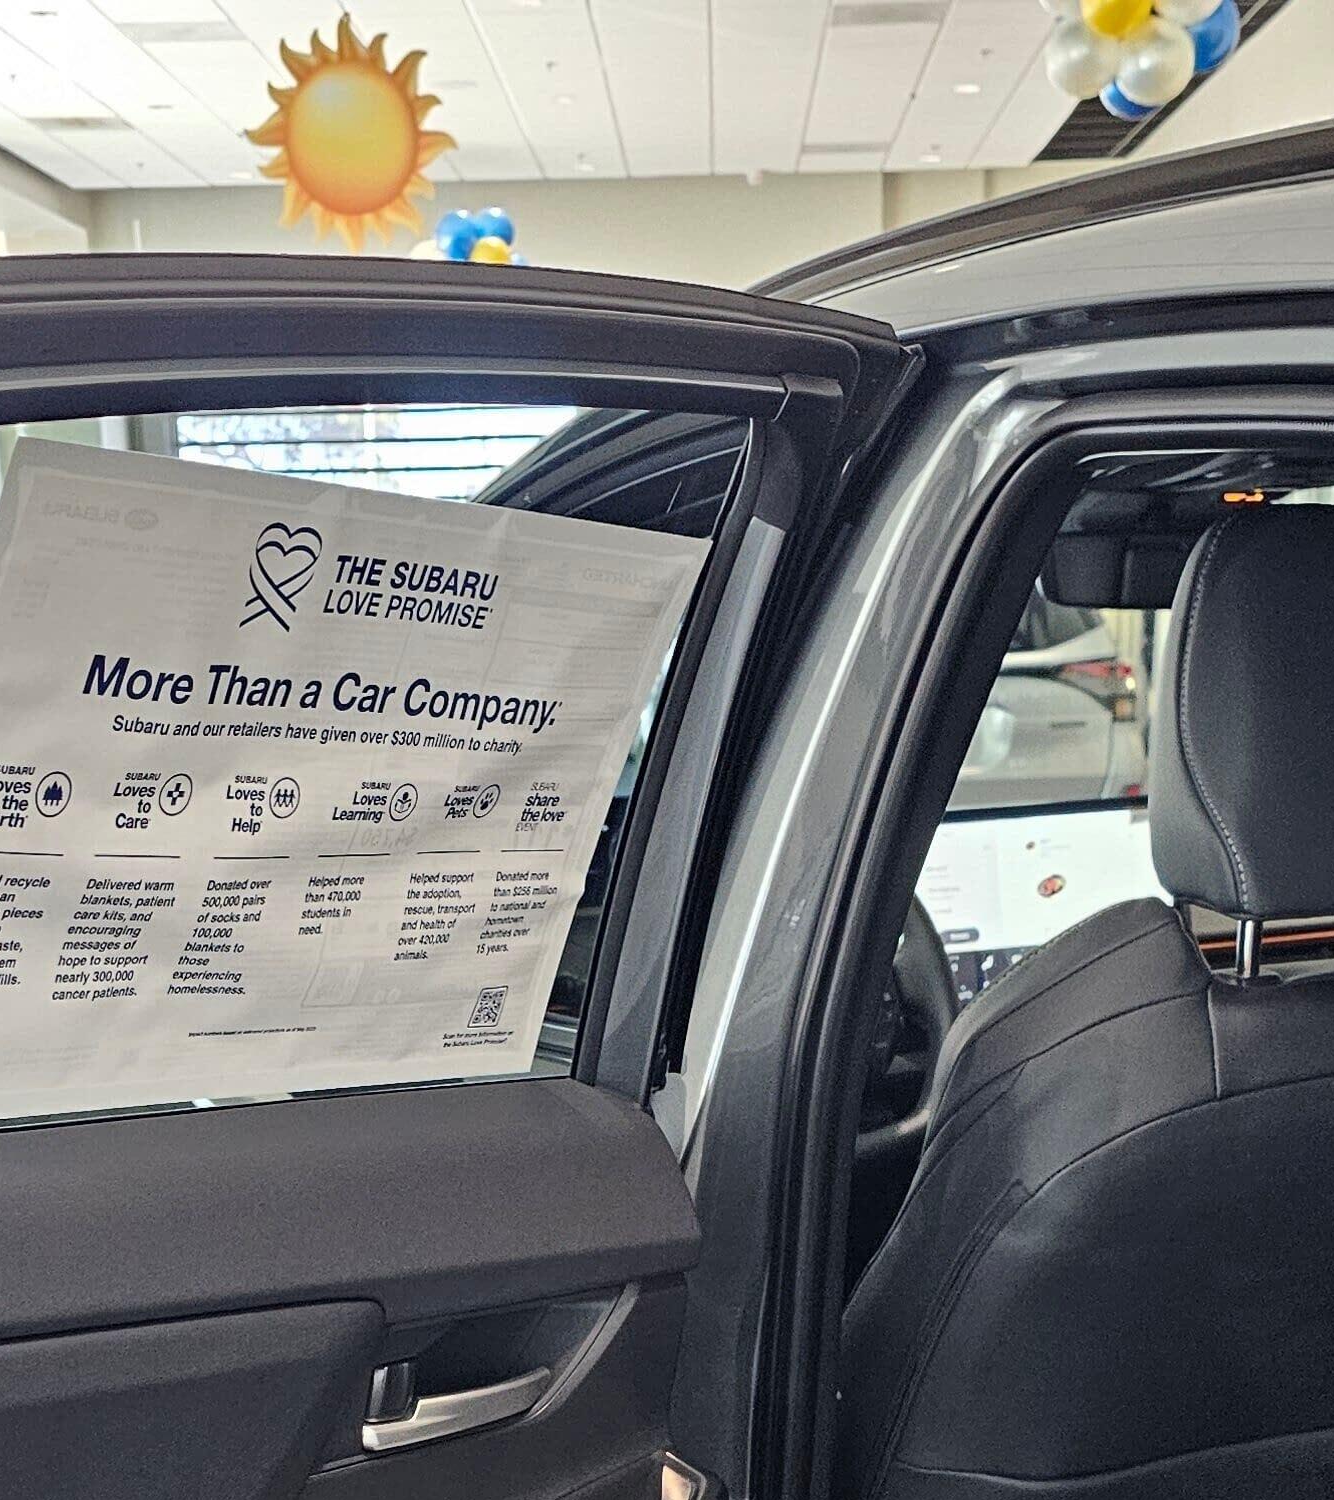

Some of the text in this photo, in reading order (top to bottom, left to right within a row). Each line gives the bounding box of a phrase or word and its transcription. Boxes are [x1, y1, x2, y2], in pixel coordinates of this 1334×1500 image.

[335, 555, 499, 601] THE SUBARU
[322, 589, 383, 617] LOVE
[82, 654, 194, 705] More
[208, 664, 293, 708] Than
[299, 680, 323, 709] a
[333, 672, 397, 714] Car
[112, 714, 171, 736] Subaru
[172, 721, 202, 737] and
[202, 722, 225, 737] our
[227, 721, 282, 738] retailers
[284, 723, 318, 740] have
[319, 725, 357, 745] given
[360, 730, 389, 745] over
[391, 730, 421, 747] $300
[423, 733, 465, 750] million
[468, 736, 481, 751] to
[125, 772, 162, 782] SUBARU
[234, 775, 268, 785] SUBARU
[113, 782, 156, 798] Loves
[361, 781, 392, 791] SUBARU
[454, 785, 481, 793] SUBARU
[226, 785, 266, 801] Loves
[352, 791, 388, 806] Loves
[2, 795, 29, 811] the
[137, 799, 152, 814] to
[443, 794, 475, 807] Loves
[525, 793, 560, 807] share
[250, 803, 263, 817] to
[332, 807, 384, 824] Learning
[445, 807, 469, 820] Pets
[520, 808, 565, 822] the love
[115, 813, 149, 829] Care
[231, 818, 261, 836] Help
[4, 877, 51, 889] recycle
[308, 876, 365, 888] Helped more
[409, 872, 475, 885] Helped support
[496, 871, 550, 882] Donated more
[86, 878, 174, 891] Delivered warm
[207, 879, 272, 891] Donated over
[494, 886, 511, 897] than
[532, 885, 558, 896] million
[304, 890, 361, 903] than 470,000
[407, 888, 462, 900] the adoption,
[79, 894, 176, 908] blankets, patient
[202, 894, 266, 908] 500,000 pairs
[489, 900, 547, 912] to national and
[1, 907, 44, 920] pieces
[73, 910, 153, 922] care kits, and
[301, 906, 352, 919] students in
[404, 903, 476, 916] rescue, transport
[197, 910, 262, 923] of socks and
[484, 916, 525, 926] hometown
[298, 923, 323, 935] need.
[401, 918, 457, 931] and health of
[67, 925, 142, 938] encouraging
[192, 927, 233, 938] 100,000
[479, 928, 531, 940] charities over
[62, 940, 137, 952] messages of
[184, 941, 245, 953] blankets to
[398, 936, 417, 946] over
[393, 950, 429, 961] animals.
[476, 943, 509, 955] 15 years.
[57, 955, 148, 969] hope to support
[177, 955, 210, 966] those
[54, 970, 134, 985] nearly 300,000
[172, 970, 242, 983] experiencing
[52, 986, 137, 1001] cancer patients.
[167, 984, 246, 995] homelessness.
